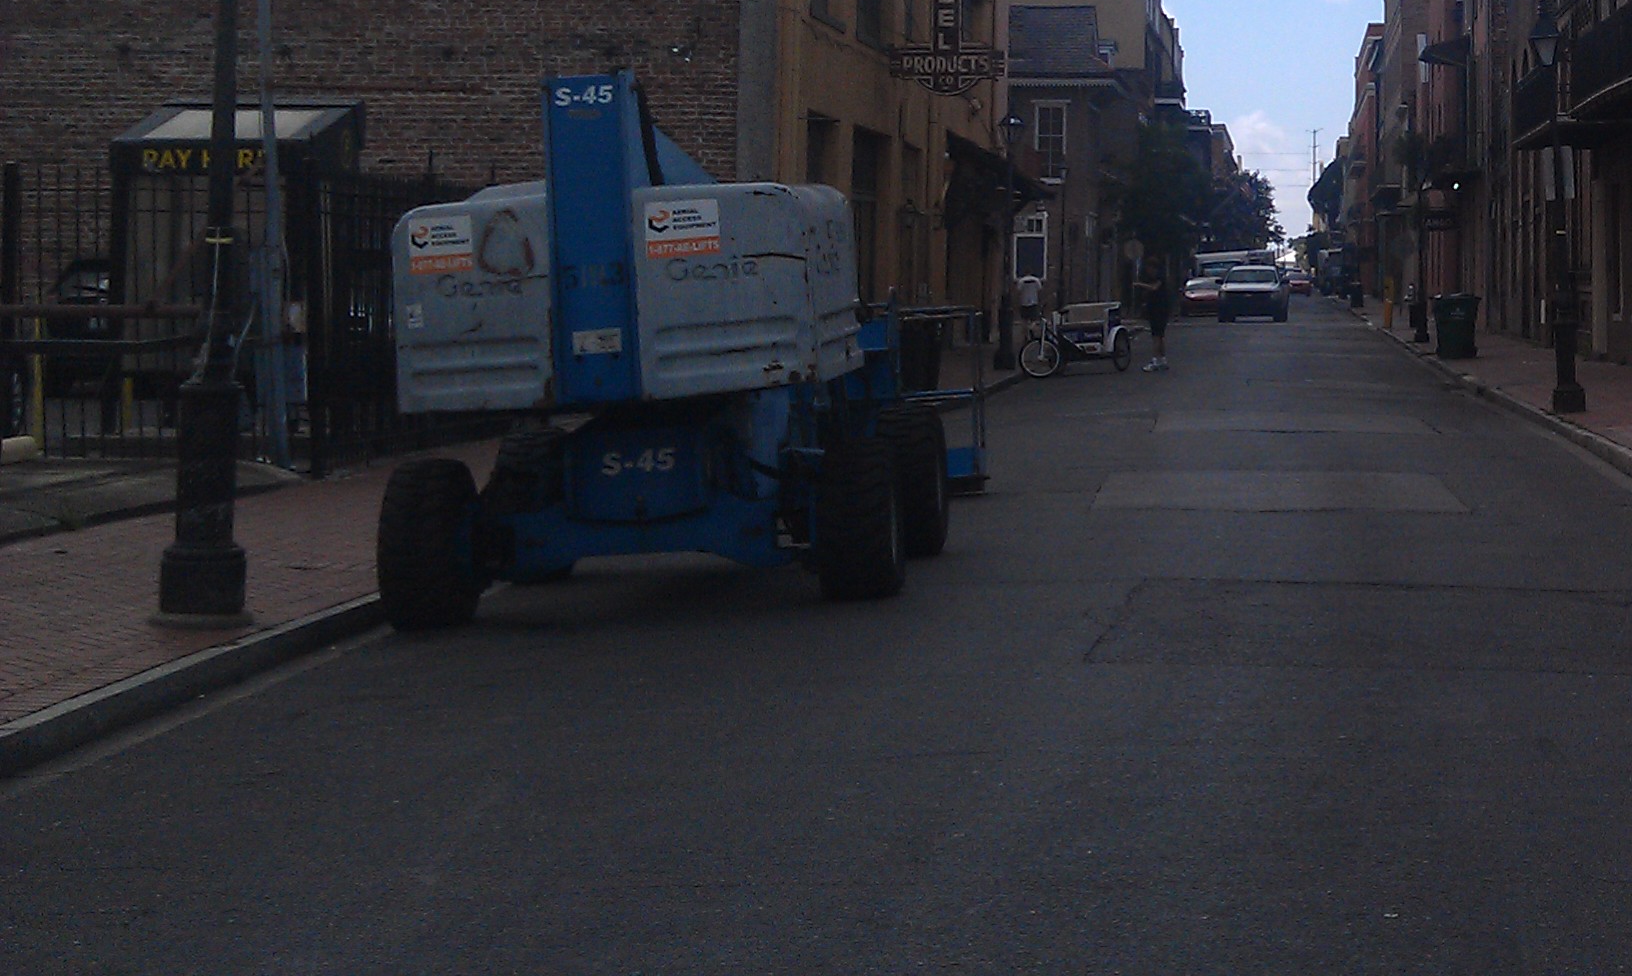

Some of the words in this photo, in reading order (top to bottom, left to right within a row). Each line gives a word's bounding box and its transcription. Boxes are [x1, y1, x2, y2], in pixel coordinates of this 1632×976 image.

[902, 55, 989, 73] PRODUCTS
[554, 84, 614, 107] S-45
[143, 148, 192, 170] PAY
[666, 255, 759, 281] Genie
[601, 447, 675, 476] S-45
